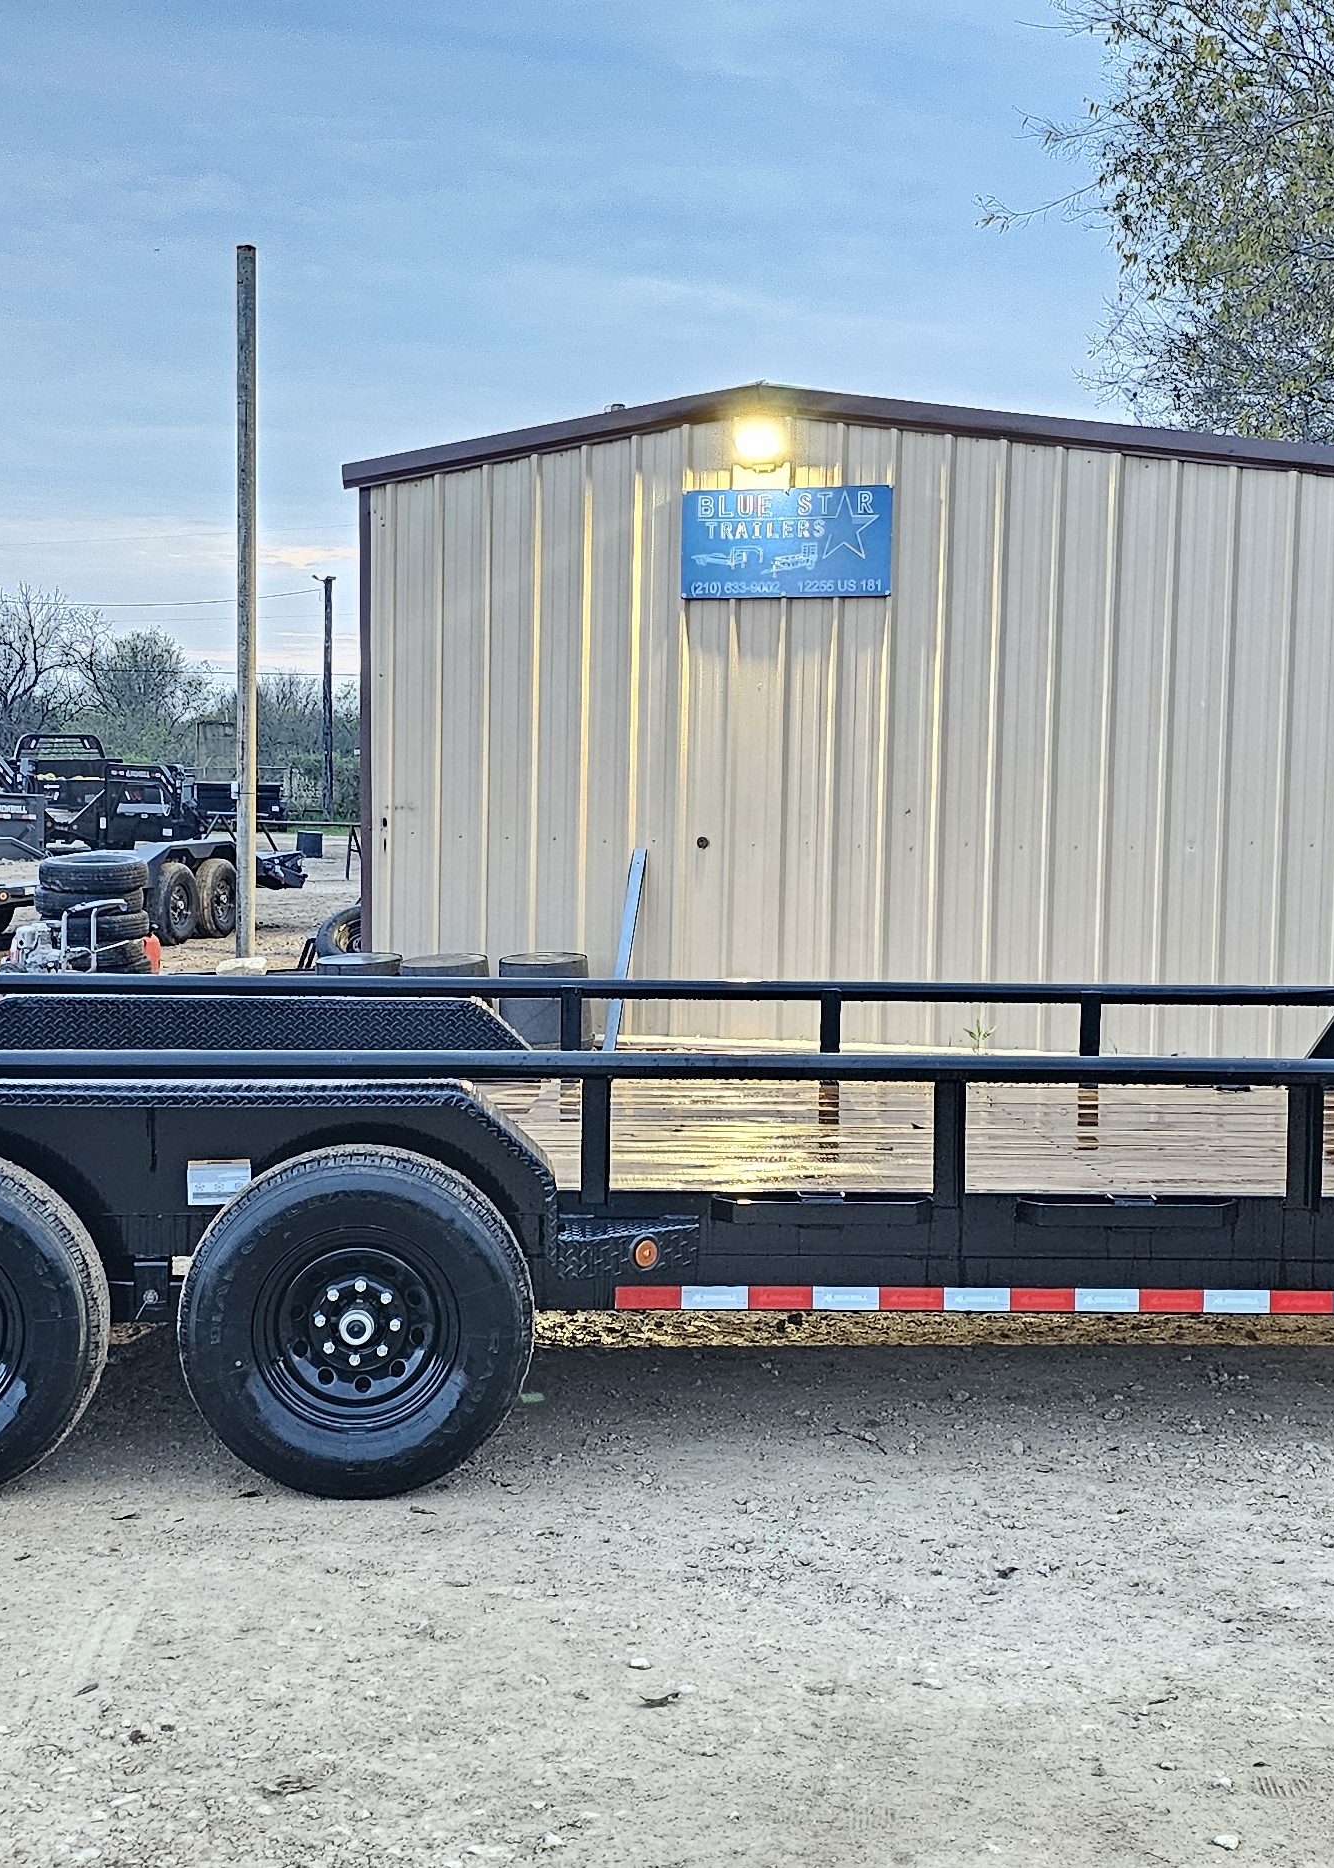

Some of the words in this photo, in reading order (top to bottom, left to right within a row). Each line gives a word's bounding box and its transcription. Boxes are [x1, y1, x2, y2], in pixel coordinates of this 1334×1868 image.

[697, 493, 774, 518] BLUE
[705, 519, 826, 541] TRAILERS
[690, 581, 722, 597] (210)
[837, 578, 857, 593] US
[860, 577, 882, 592] 181
